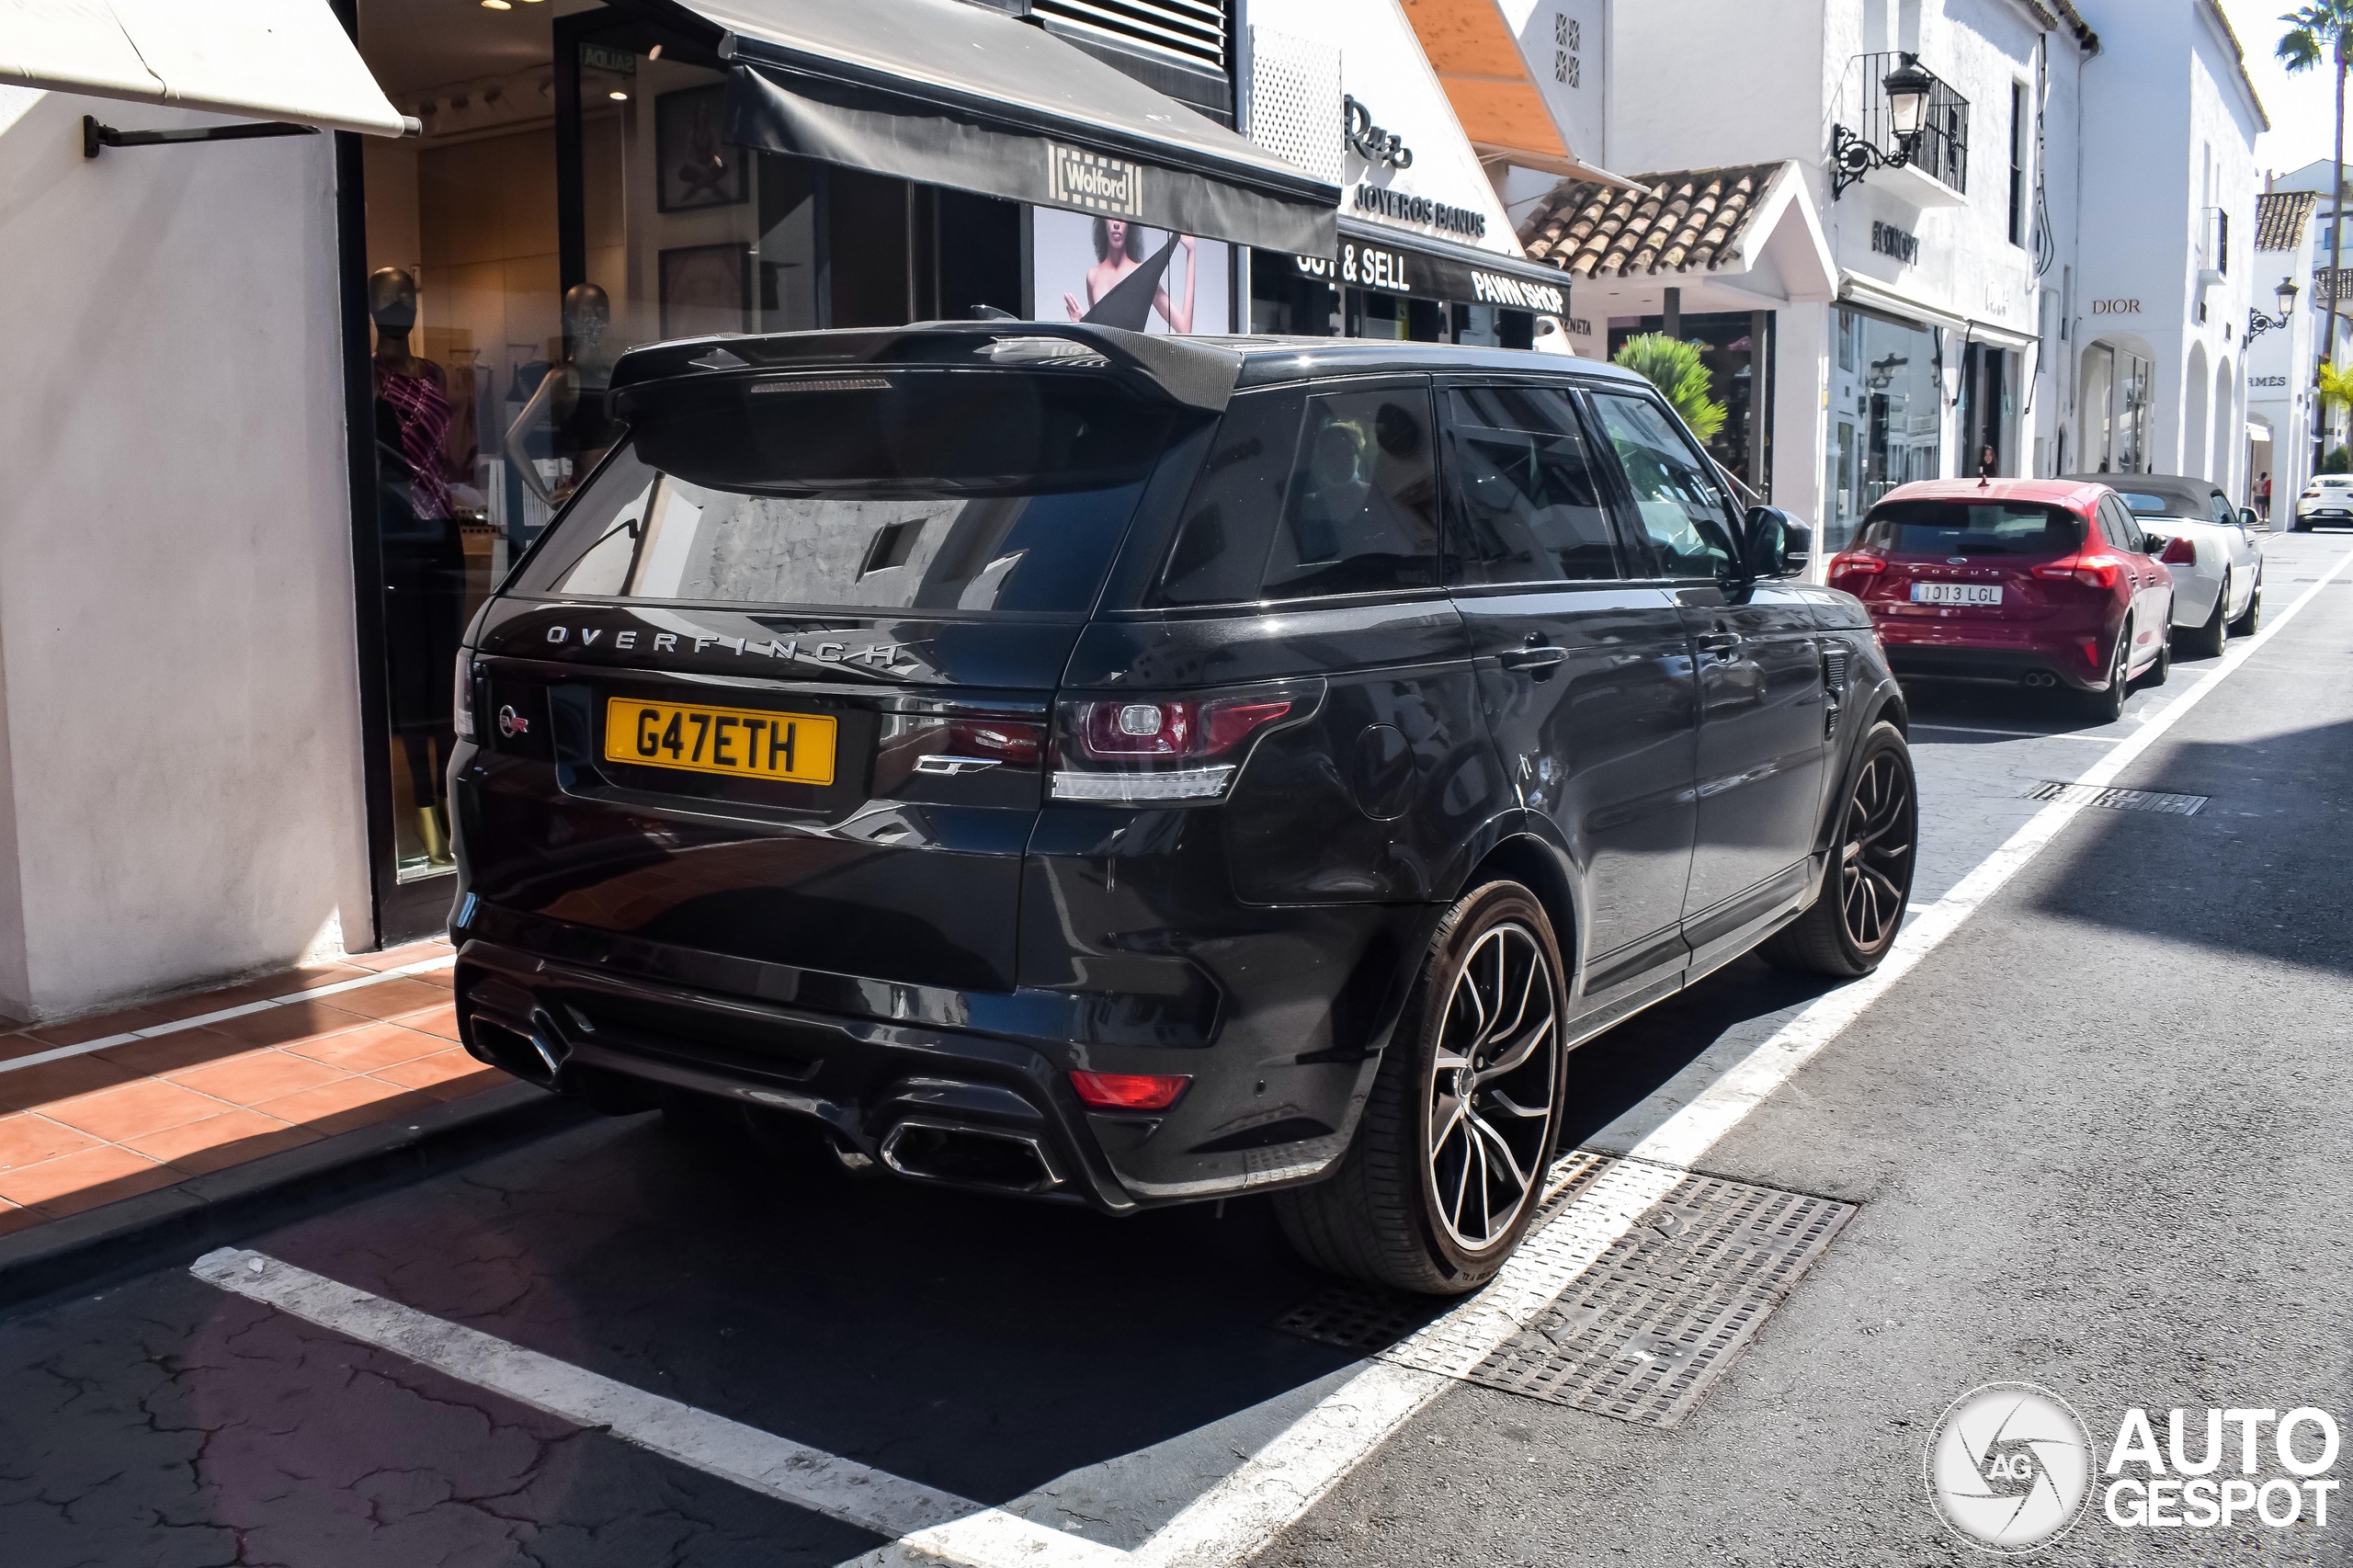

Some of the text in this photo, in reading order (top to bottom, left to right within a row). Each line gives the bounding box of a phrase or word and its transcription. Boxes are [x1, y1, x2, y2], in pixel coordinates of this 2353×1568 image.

[1065, 161, 1127, 201] Wolford
[1354, 184, 1486, 238] JOYEROS BANUS
[1343, 244, 1358, 281] &
[1361, 247, 1411, 291] SELL
[1471, 270, 1563, 314] PAWN SHOP
[2092, 299, 2142, 313] DIOR
[1925, 586, 1998, 602] 1013 LGL
[547, 626, 898, 665] OVERFINCH
[636, 709, 796, 772] G47ETH
